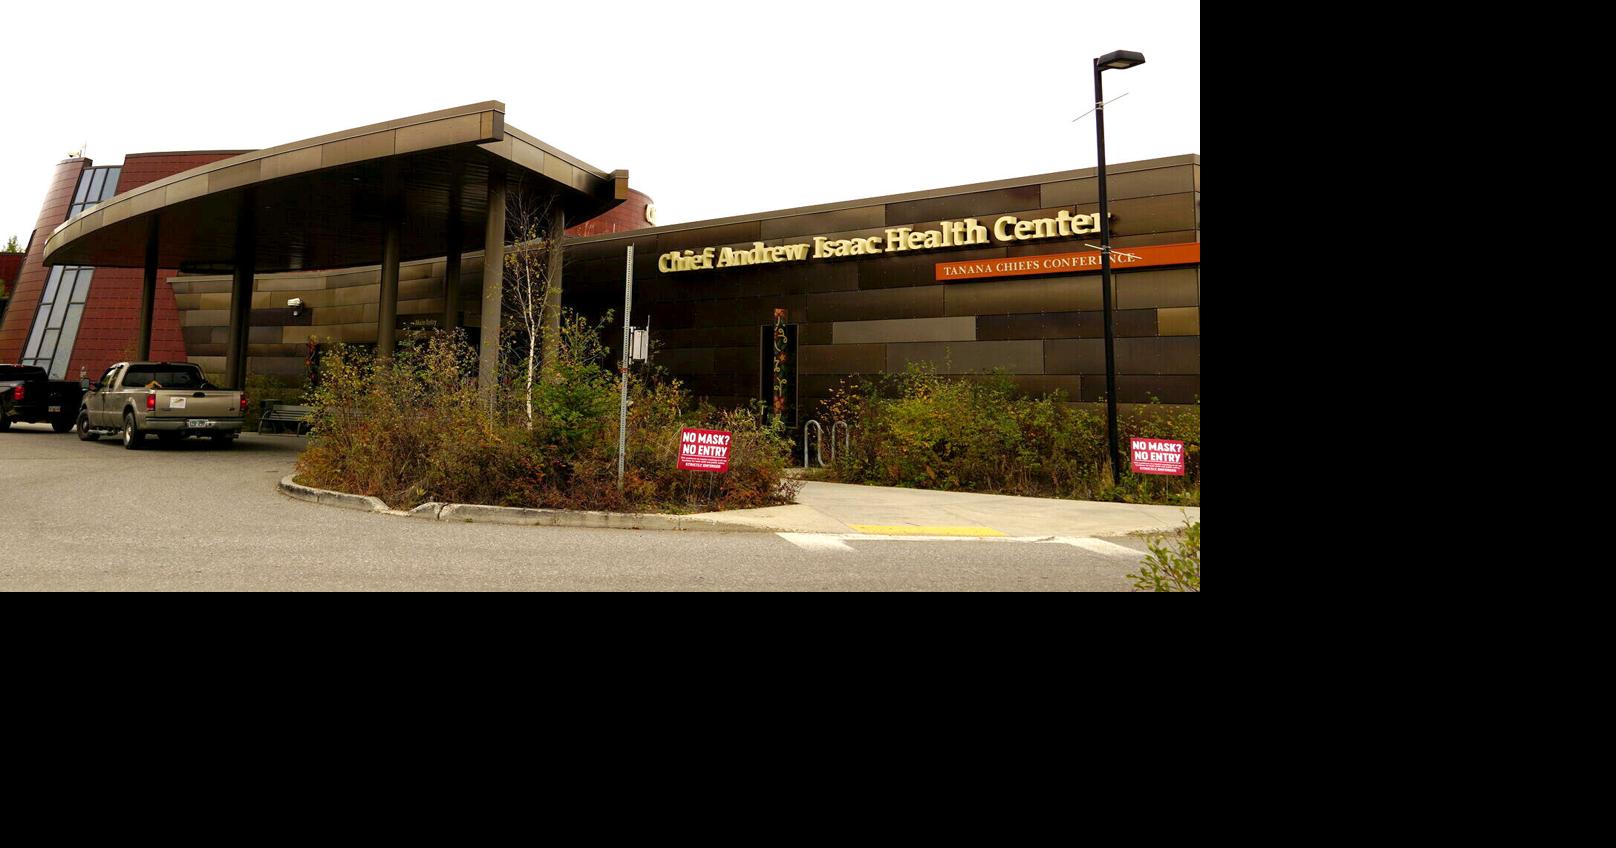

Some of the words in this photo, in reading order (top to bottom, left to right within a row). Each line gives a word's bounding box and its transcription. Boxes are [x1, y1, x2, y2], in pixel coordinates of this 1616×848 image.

[658, 247, 715, 273] Chief
[716, 241, 810, 267] Andrew
[812, 236, 883, 259] Isaac
[885, 218, 990, 252] Health
[943, 263, 993, 276] TANANA
[996, 260, 1040, 273] CHIEFS
[682, 432, 696, 443] NO
[698, 433, 730, 446] MASK?
[682, 444, 696, 455] NO
[698, 445, 728, 457] ENTRY
[1132, 441, 1146, 450] NO
[1148, 442, 1182, 453] MASK?
[1134, 451, 1148, 460] NO
[1150, 452, 1181, 463] ENTRY
